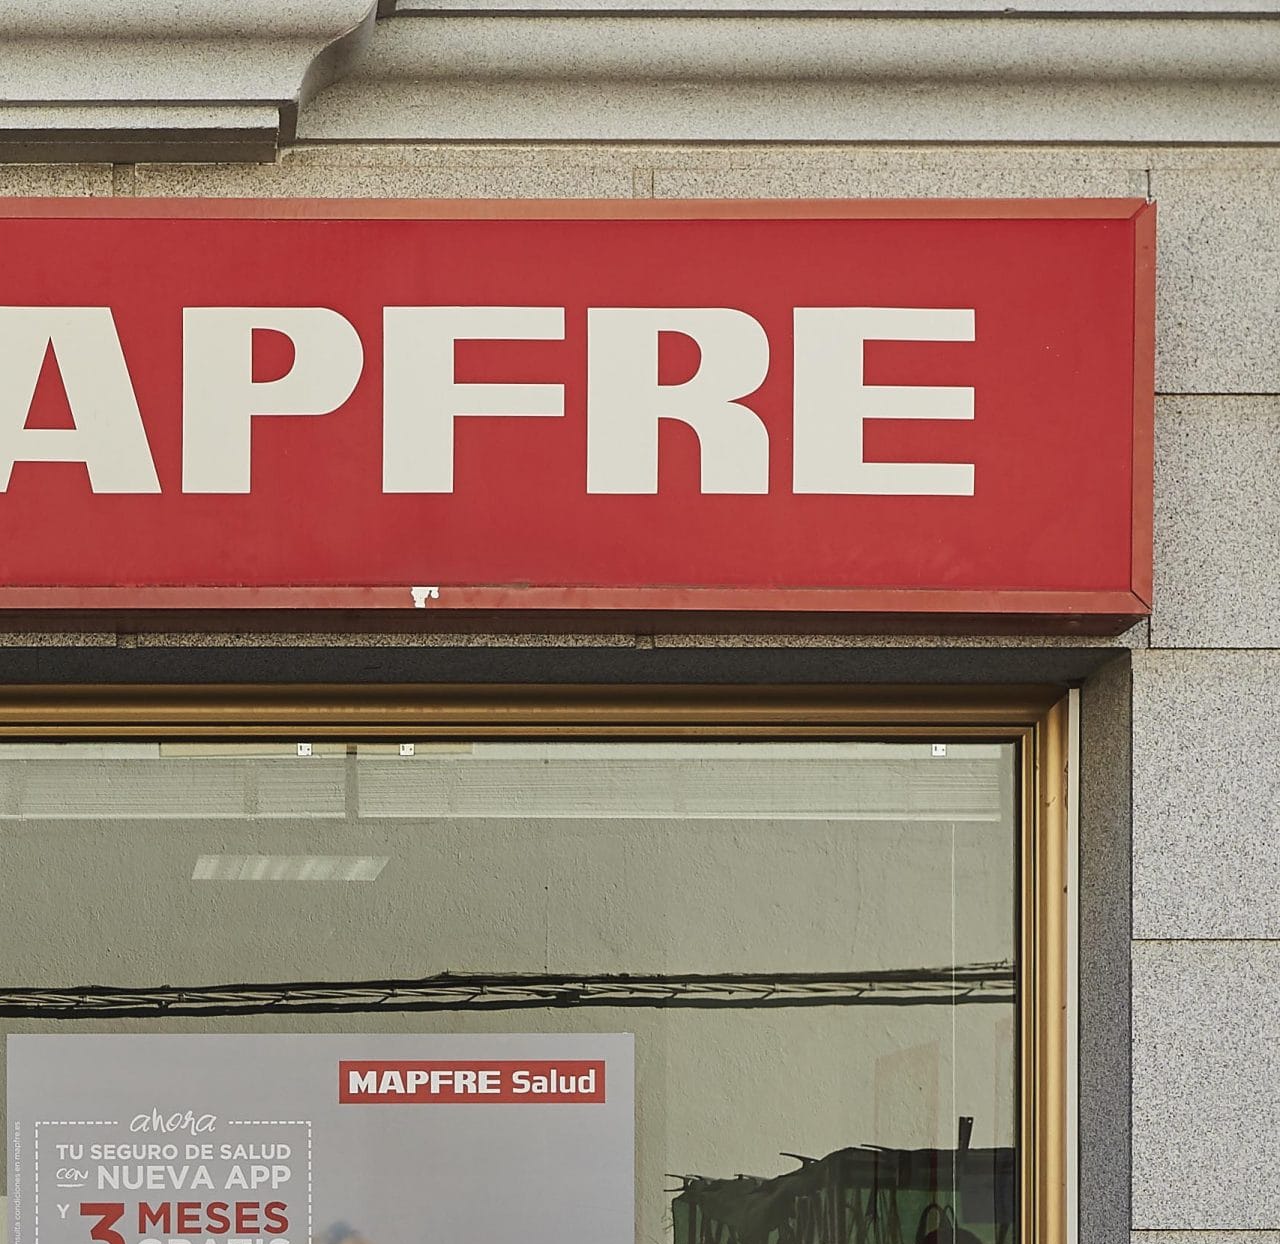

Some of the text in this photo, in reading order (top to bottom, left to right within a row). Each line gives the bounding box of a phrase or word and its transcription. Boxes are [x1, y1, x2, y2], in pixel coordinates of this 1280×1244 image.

[348, 1069, 596, 1094] MAPFRE Salud
[129, 1107, 217, 1136] ahora
[55, 1144, 291, 1160] TU SEGURO DE SALUD
[14, 1162, 22, 1172] en
[97, 1165, 215, 1190] NUEVA
[224, 1165, 291, 1190] APP
[12, 1174, 22, 1220] condiciones
[56, 1203, 70, 1219] Y
[137, 1201, 289, 1234] MESES
